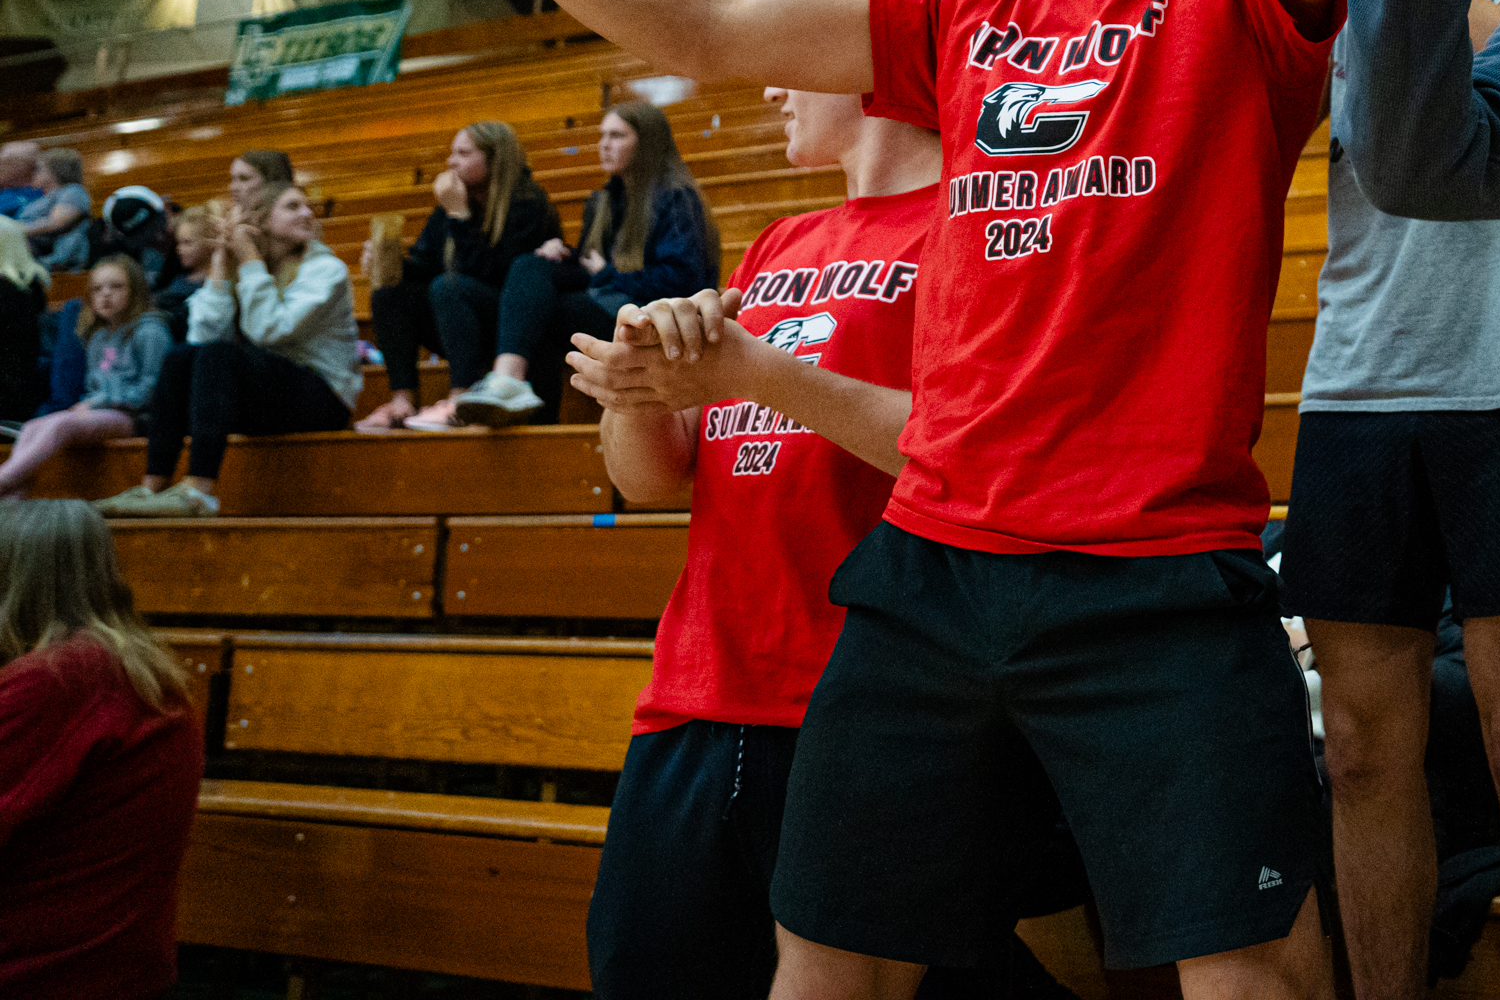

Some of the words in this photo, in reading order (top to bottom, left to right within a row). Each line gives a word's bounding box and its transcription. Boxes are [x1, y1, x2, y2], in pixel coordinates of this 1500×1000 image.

[949, 169, 1038, 219] UMMER
[1040, 156, 1157, 207] AWARD
[985, 214, 1052, 260] 2024
[740, 267, 819, 312] RON
[810, 260, 918, 304] WOLF
[732, 441, 782, 476] 2024
